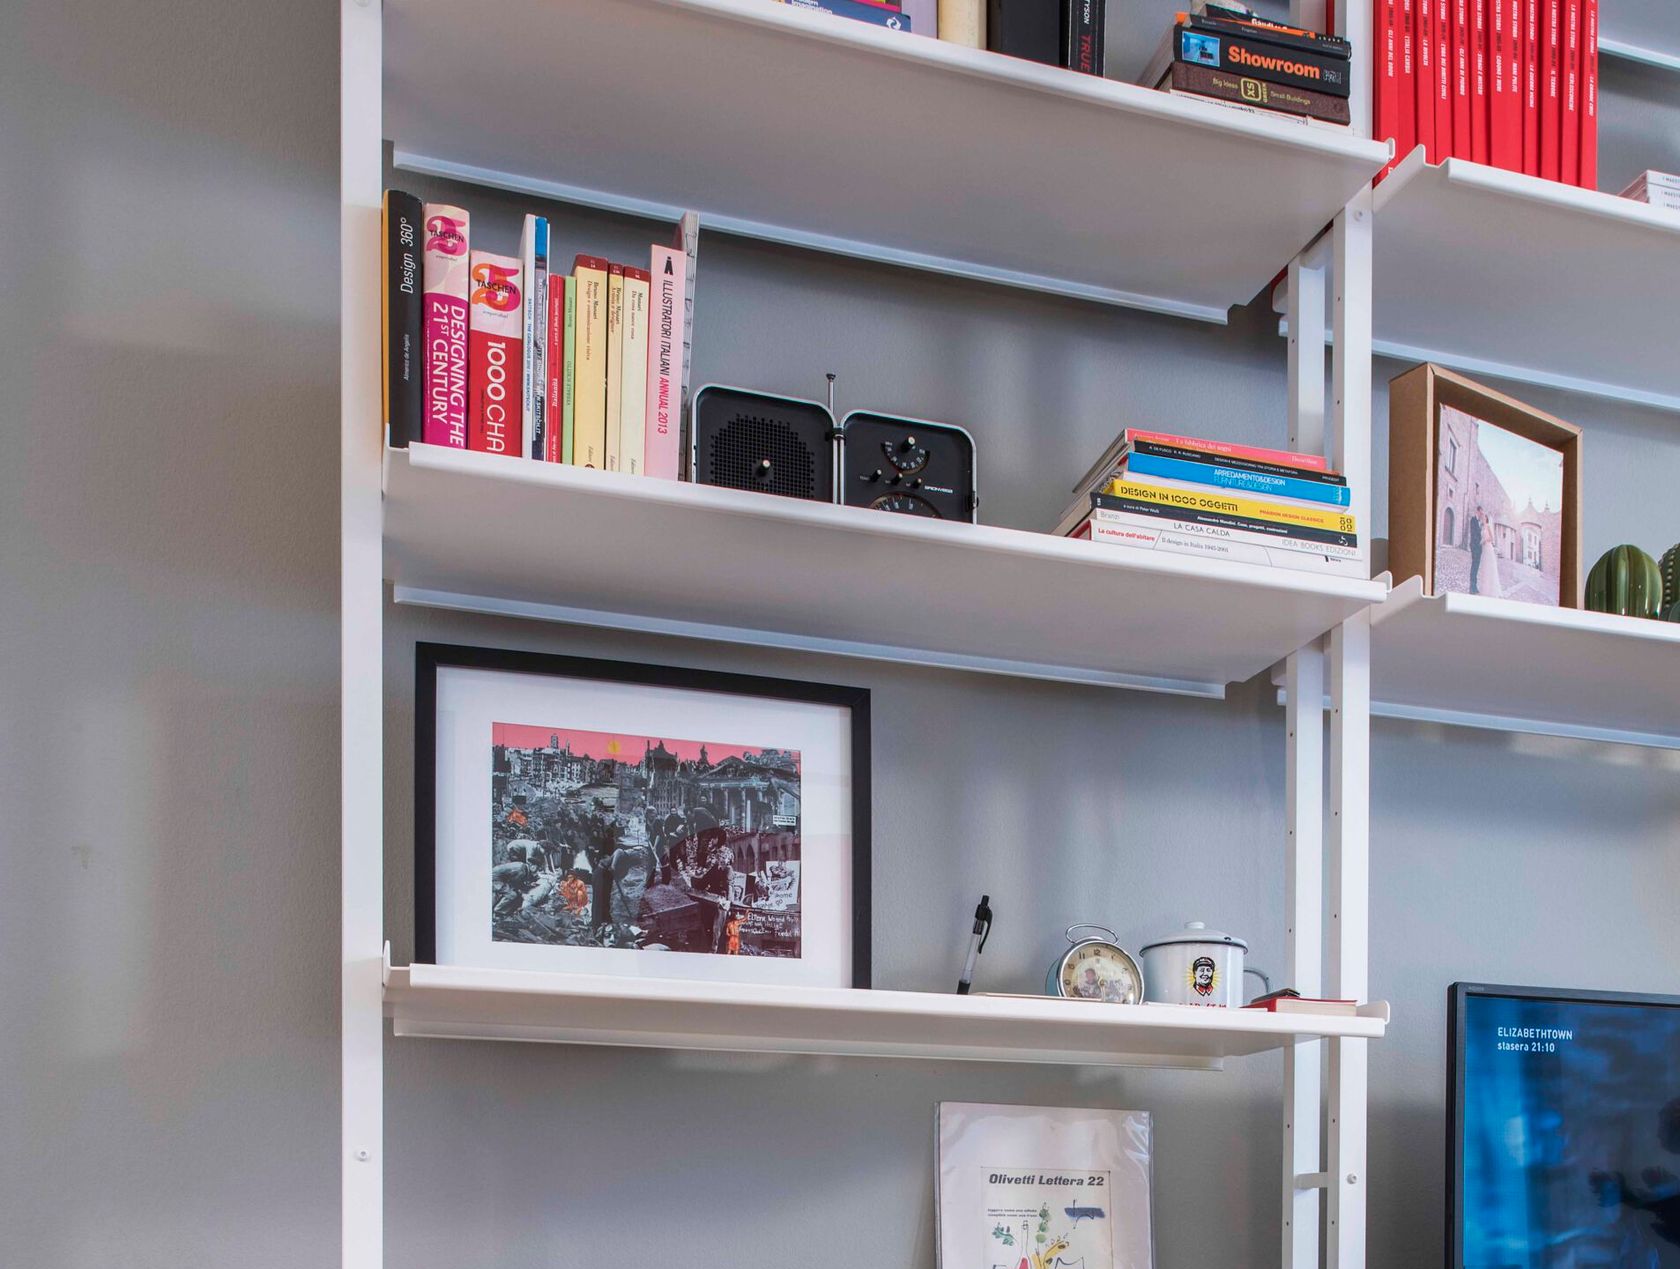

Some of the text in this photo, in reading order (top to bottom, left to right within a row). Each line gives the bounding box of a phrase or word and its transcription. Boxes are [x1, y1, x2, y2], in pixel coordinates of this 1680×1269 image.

[1081, 34, 1091, 72] TRUE
[1228, 45, 1320, 79] Showroom
[429, 229, 465, 243] TASCHEN
[400, 253, 416, 294] Design
[476, 279, 516, 294] TASCHEN
[658, 279, 674, 435] ILLUSTRATORI ITALIANI ANNUAL 2013
[449, 305, 465, 447] DESIGNING THE
[487, 341, 506, 401] 1000
[432, 340, 448, 424] CENTURY
[486, 403, 506, 452] CHA
[1213, 468, 1286, 486] ARREDAMENTO&DESIGN
[1120, 486, 1238, 512] DESIGN IN 1000 OGGETTI
[1100, 511, 1120, 520] Branzi
[1105, 528, 1125, 538] cultura
[1125, 530, 1156, 541] dell'abitare
[1174, 522, 1231, 537] LA CASA CALDA
[1166, 538, 1183, 547] design
[1281, 538, 1356, 556] IDEA BOOKS EDIZIONI
[1497, 1026, 1573, 1041] ELIZABETHTOWN
[1497, 1042, 1555, 1053] stasera 21:10
[989, 1173, 1105, 1187] Olivetti Lettera 22
